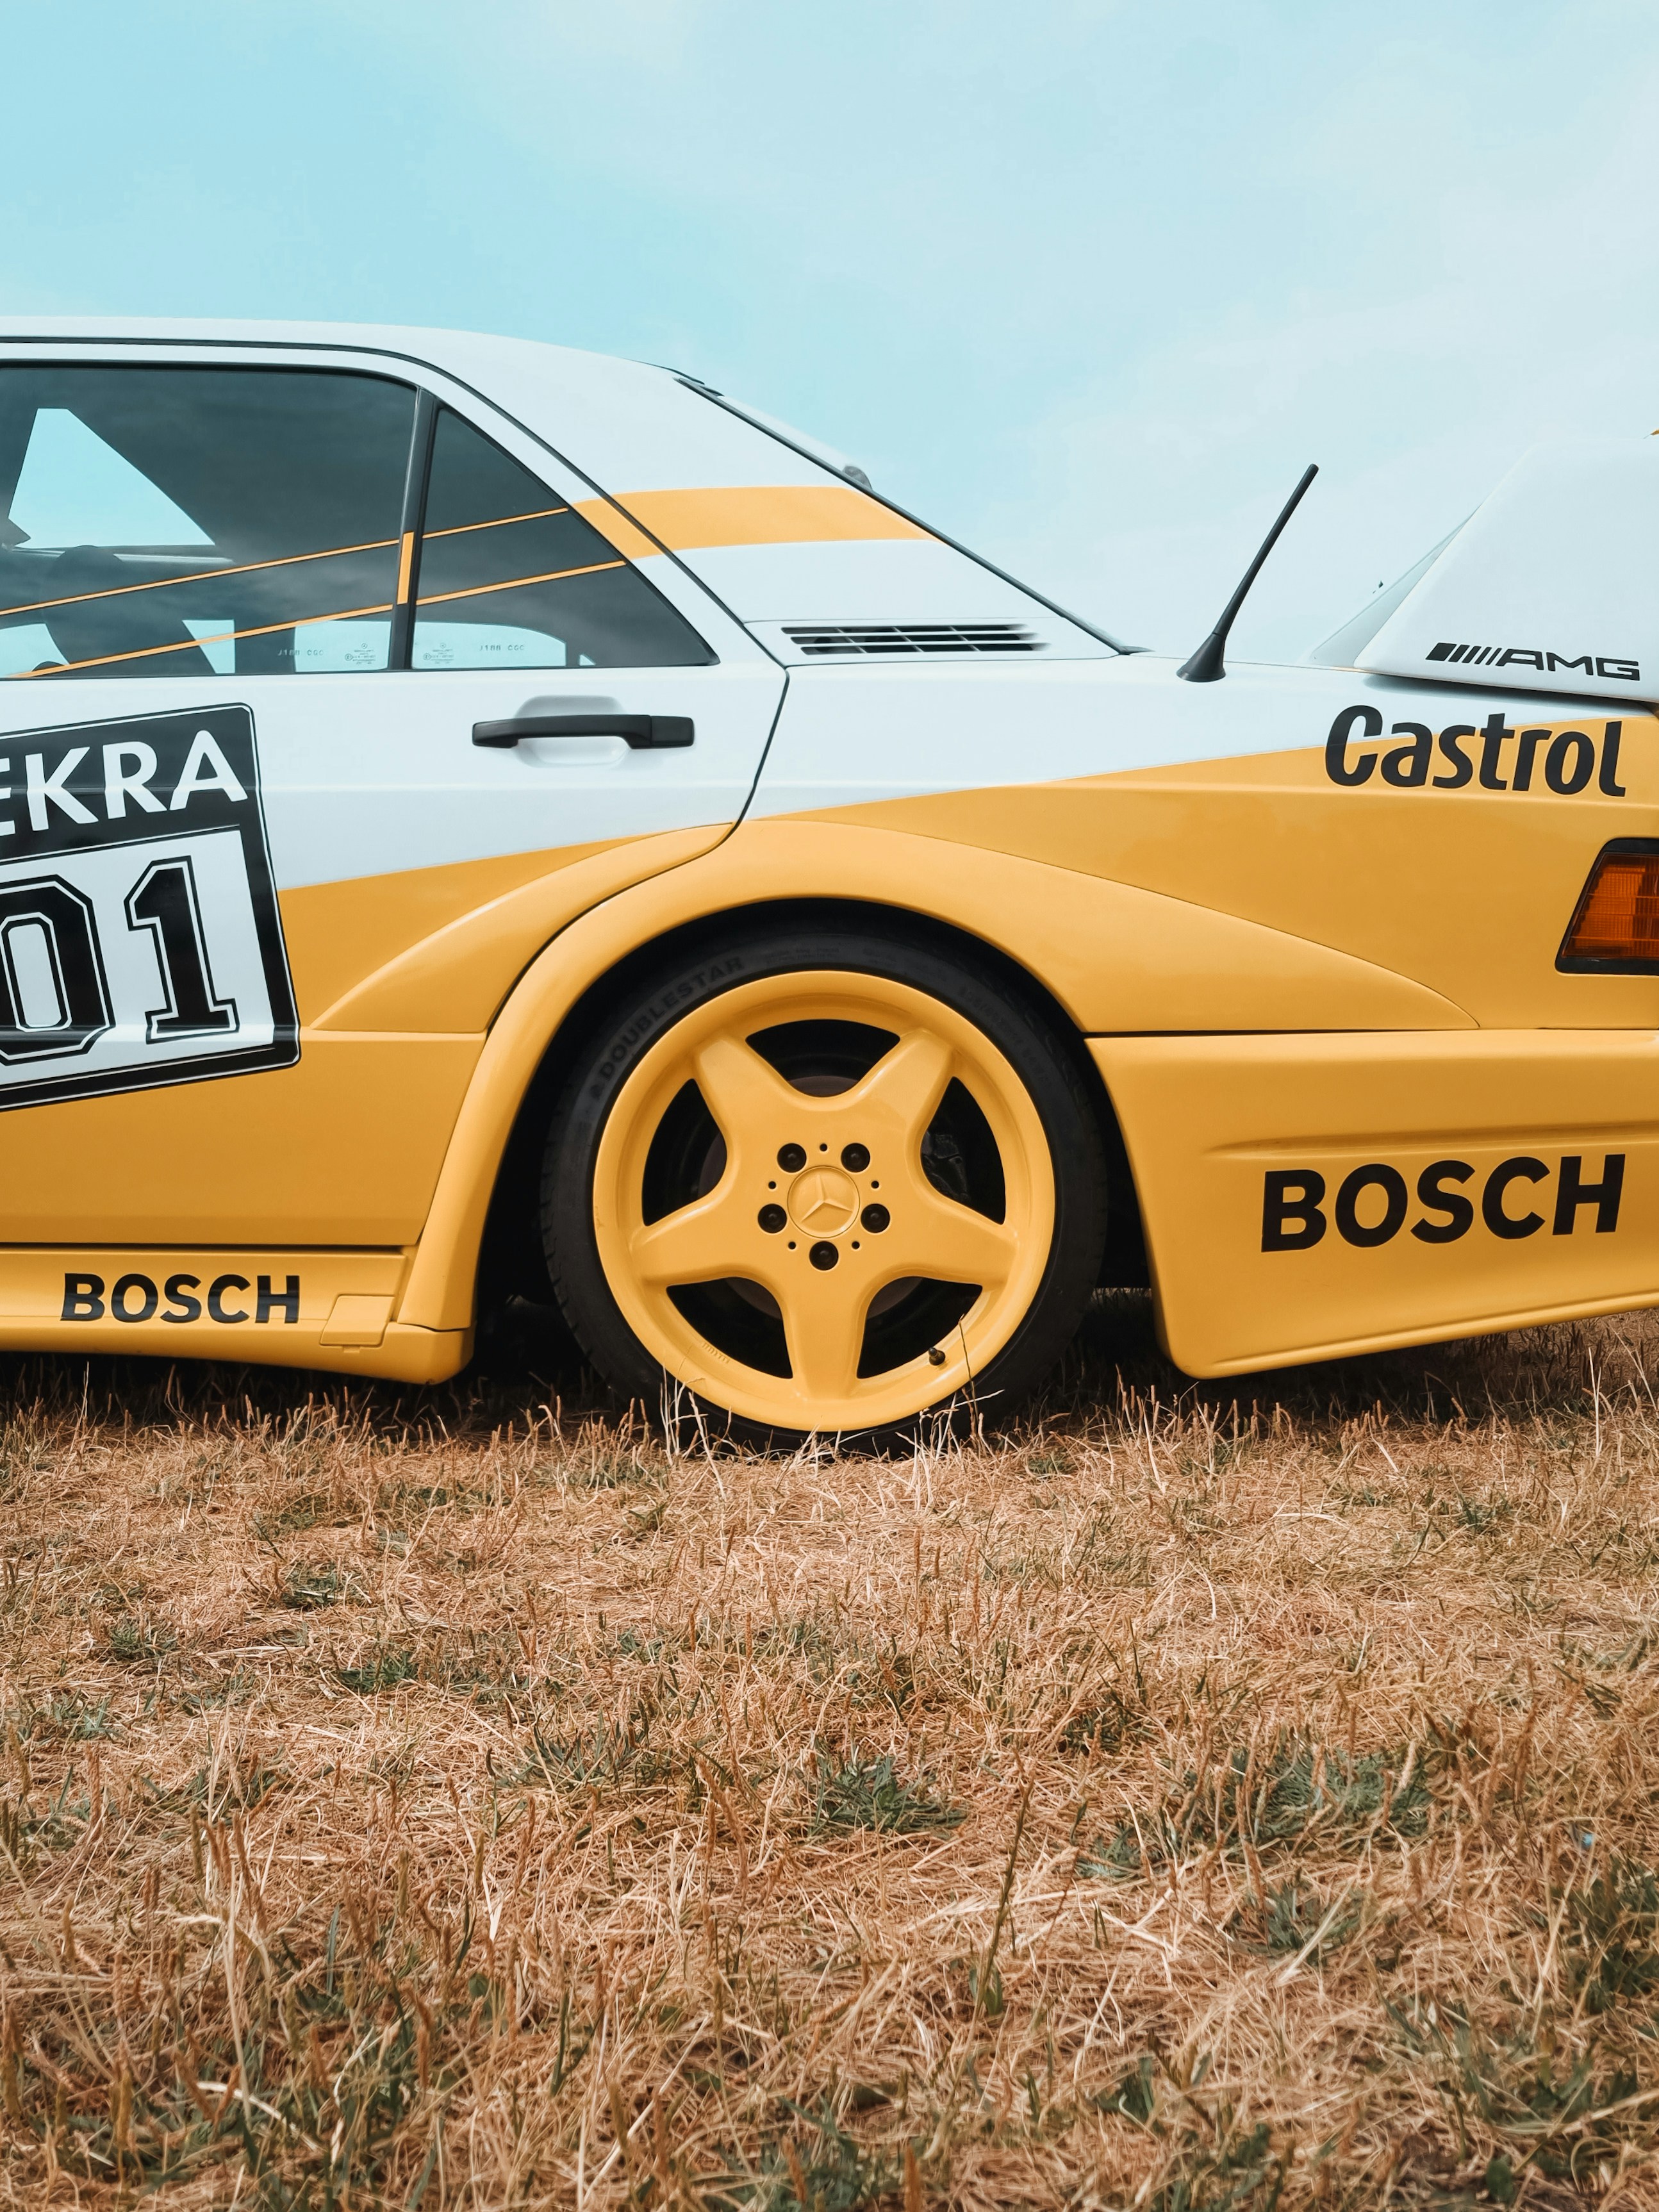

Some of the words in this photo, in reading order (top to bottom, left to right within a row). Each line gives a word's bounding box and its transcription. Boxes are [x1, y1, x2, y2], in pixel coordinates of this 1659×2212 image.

[1496, 648, 1640, 681] AMG
[1325, 705, 1626, 797] Castrol
[599, 957, 745, 1081] DOUBLESTAR
[1261, 1153, 1625, 1253] BOSCH
[60, 1273, 299, 1324] BOSCH
